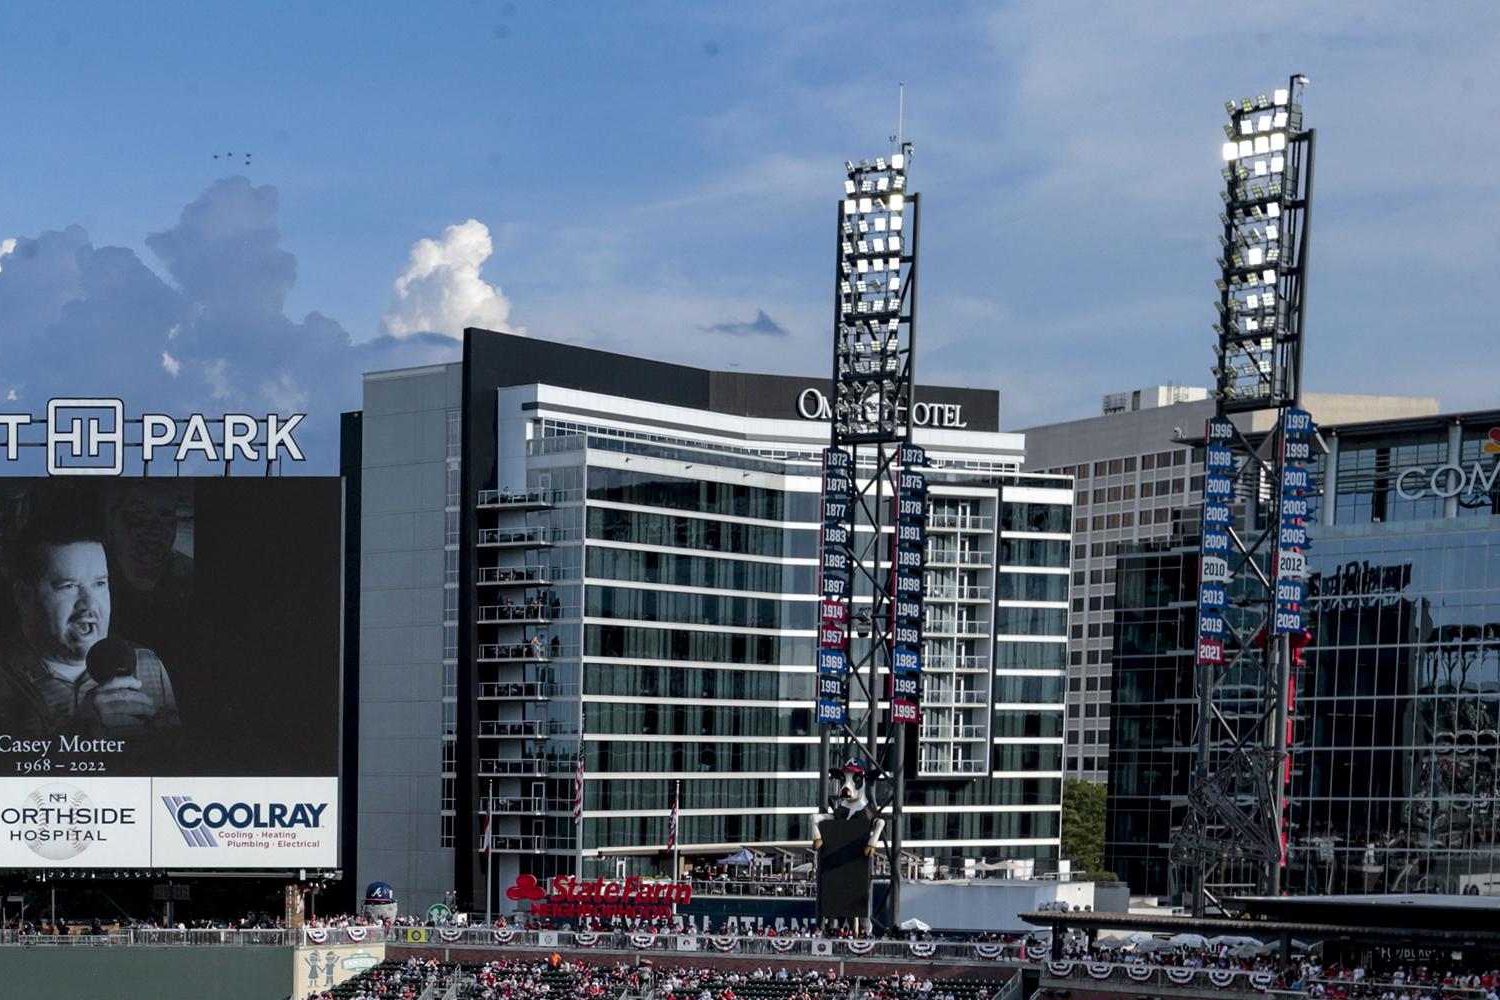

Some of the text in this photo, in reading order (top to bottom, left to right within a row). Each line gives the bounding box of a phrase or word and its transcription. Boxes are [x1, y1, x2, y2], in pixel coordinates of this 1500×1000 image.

[1209, 422, 1234, 438] 1996
[1286, 414, 1311, 430] 1997
[141, 413, 307, 461] PARK
[901, 448, 924, 464] 1873
[1208, 450, 1232, 467] 1998
[1285, 443, 1310, 459] 1999
[826, 452, 849, 467] 1872
[826, 477, 849, 492] 1874
[901, 474, 924, 489] 1875
[1207, 478, 1231, 494] 2000
[1284, 471, 1308, 487] 2001
[825, 502, 847, 518] 1877
[900, 500, 923, 515] 1878
[1205, 506, 1230, 522] 2002
[1282, 500, 1307, 516] 2003
[824, 527, 847, 543] 1883
[899, 526, 921, 541] 1891
[1281, 528, 1306, 544] 2005
[1204, 534, 1228, 550] 2004
[823, 553, 847, 568] 1892
[898, 551, 921, 566] 1893
[1279, 555, 1303, 572] 2012
[1203, 561, 1226, 577] 2010
[823, 579, 845, 594] 1897
[897, 577, 921, 592] 1898
[1278, 584, 1301, 601] 2018
[1201, 589, 1225, 605] 2013
[821, 603, 844, 620] 1914
[896, 602, 920, 618] 1948
[1200, 617, 1223, 633] 2019
[1276, 613, 1301, 629] 2020
[821, 629, 843, 645] 1957
[895, 628, 919, 643] 1958
[894, 653, 917, 668] 1982
[1199, 644, 1222, 661] 2021
[820, 654, 843, 670] 1969
[820, 679, 842, 695] 1991
[894, 679, 917, 694] 1992
[819, 704, 842, 720] 1993
[893, 704, 917, 720] 1995
[58, 735, 125, 753] Motter
[15, 758, 106, 772] 1968 2022
[177, 803, 328, 828] COOLRAY
[10, 830, 107, 841] HOSPITAL
[218, 831, 296, 840] Cooling Heating
[227, 840, 320, 850] Plumbing Electrical
[531, 904, 671, 919] NEIGHBORHOOD
